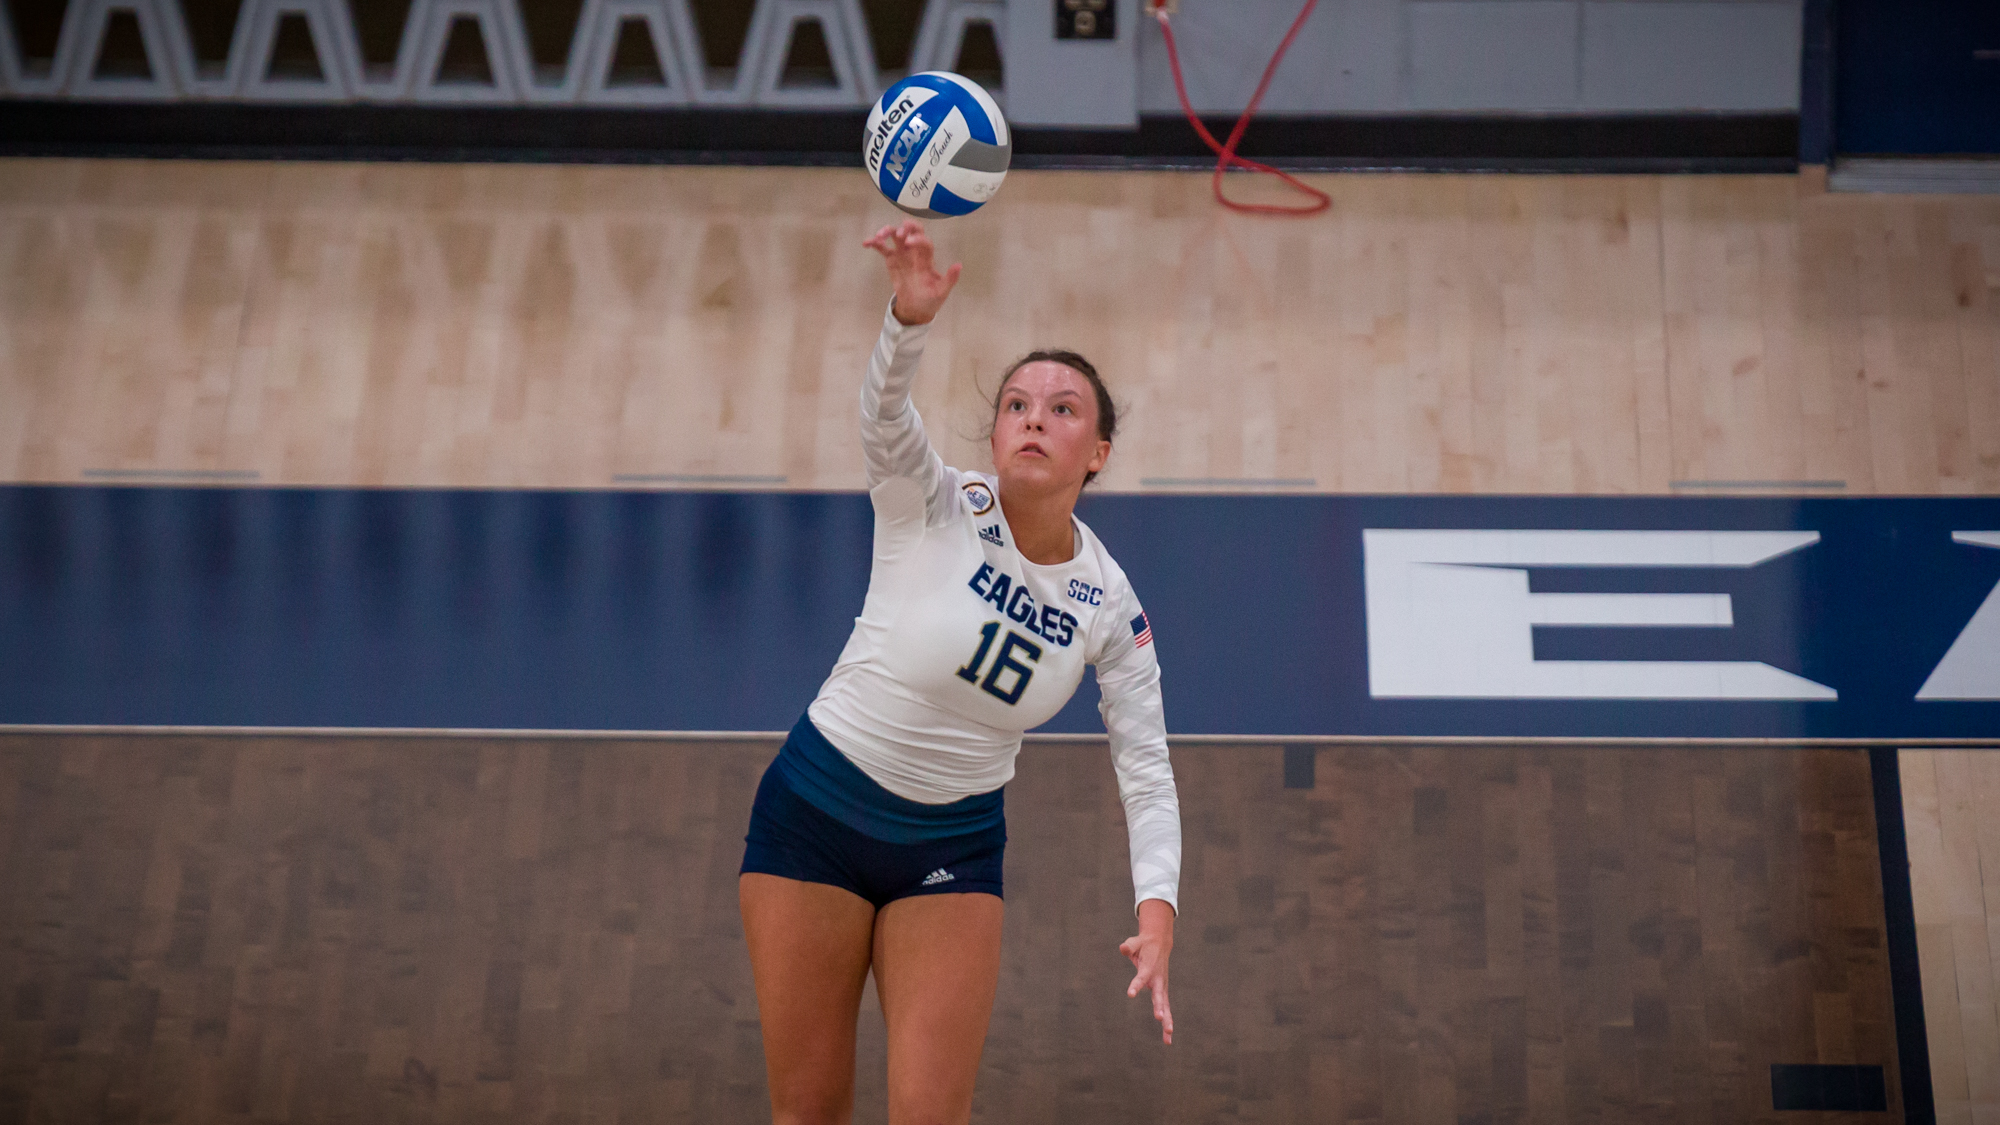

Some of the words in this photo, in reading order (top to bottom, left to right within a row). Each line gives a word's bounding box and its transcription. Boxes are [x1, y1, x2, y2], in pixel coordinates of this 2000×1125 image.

[869, 97, 914, 171] molten
[885, 115, 930, 182] NCAA
[909, 169, 932, 198] Super
[929, 129, 953, 166] Touch
[968, 561, 1079, 648] EAGLES
[1067, 578, 1104, 607] SBC
[1363, 527, 2000, 700] E
[955, 620, 1043, 706] 16
[922, 873, 955, 886] adidas
